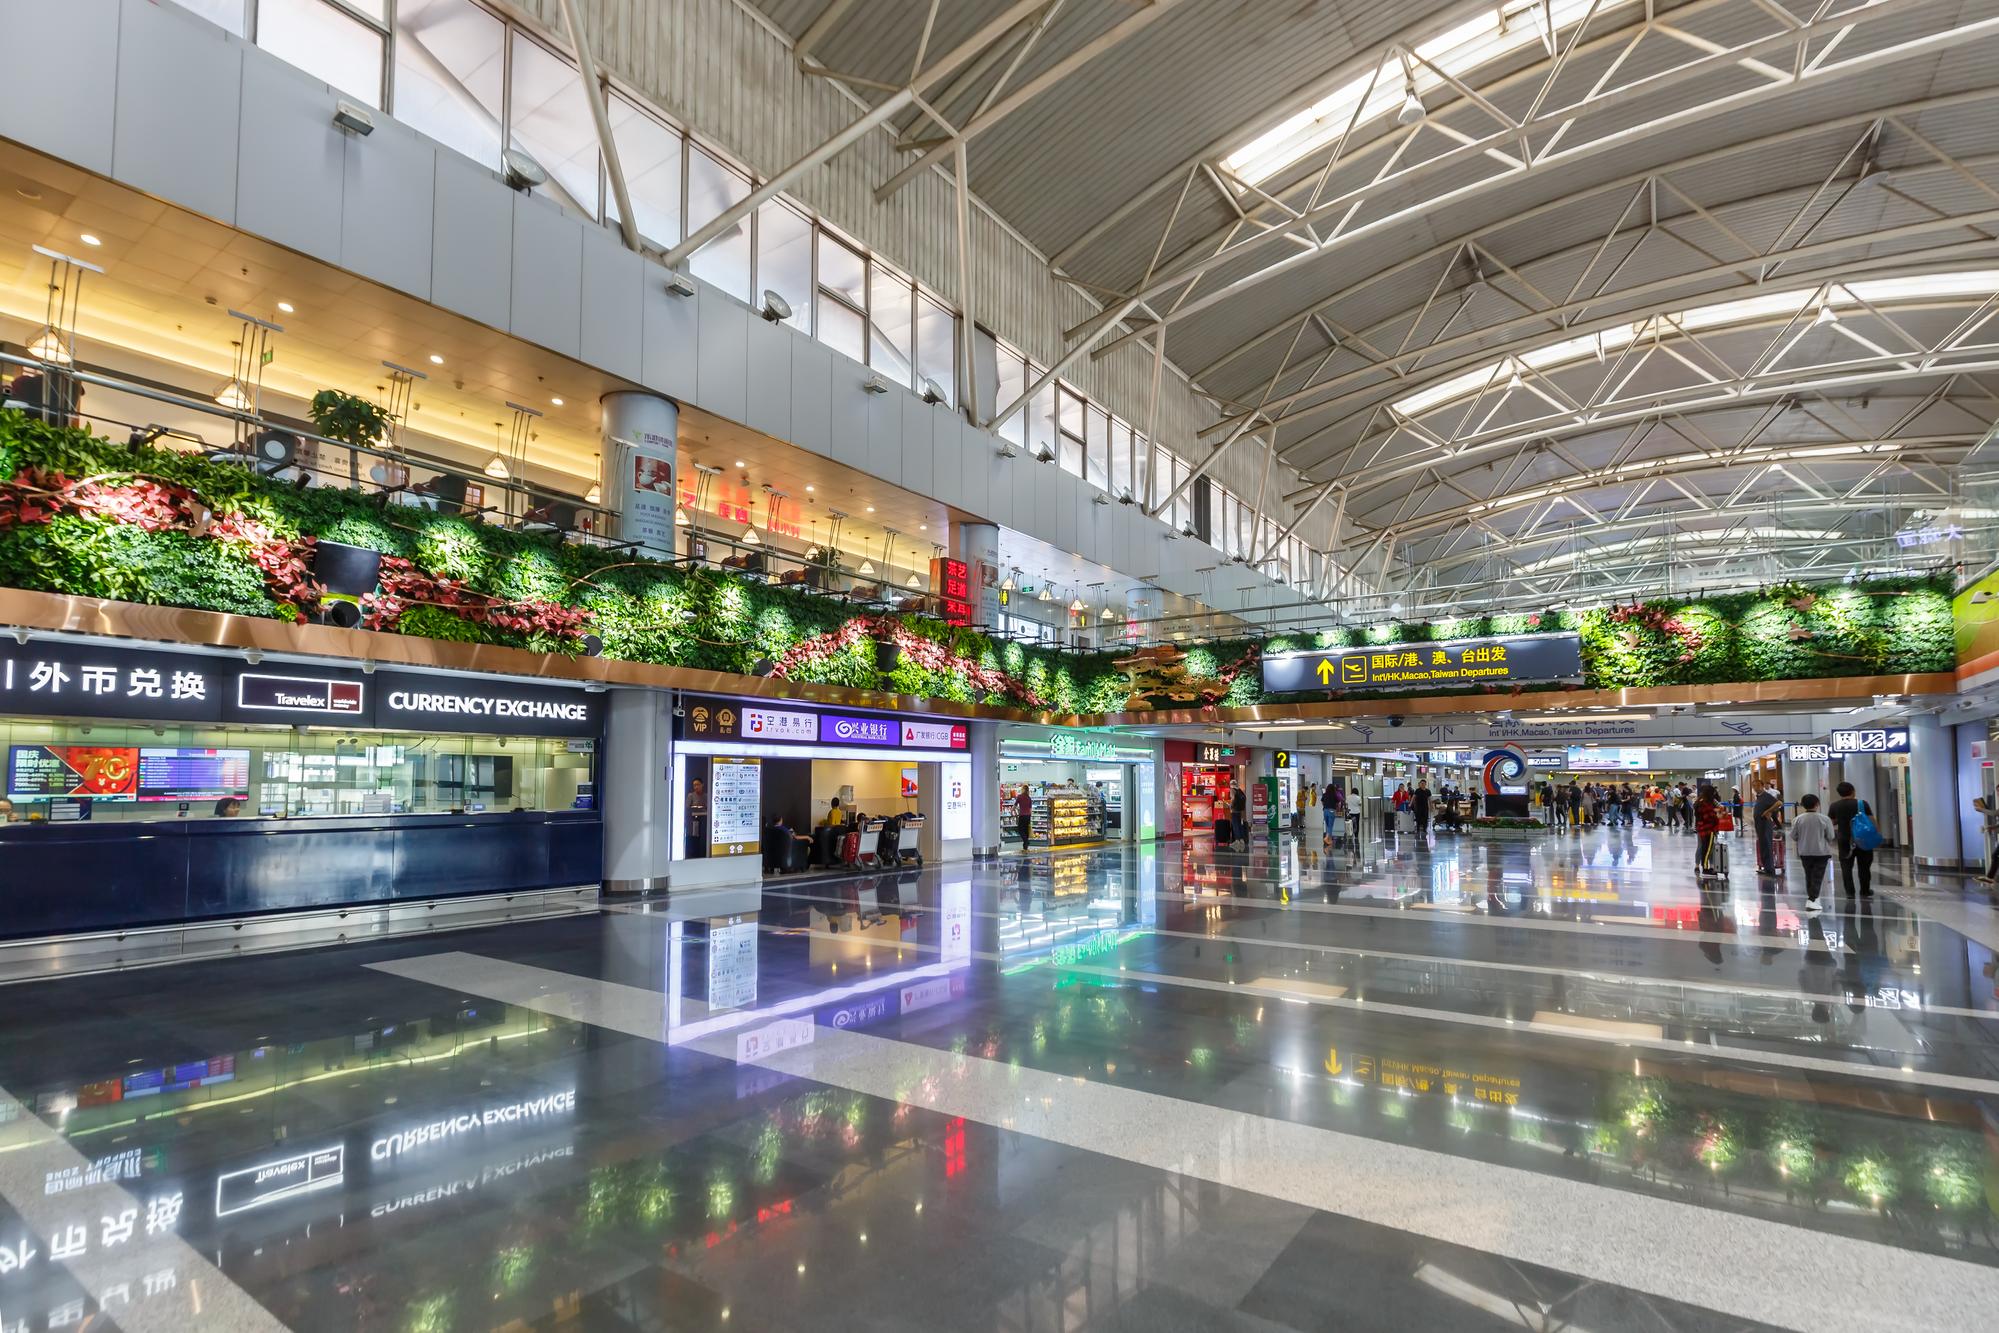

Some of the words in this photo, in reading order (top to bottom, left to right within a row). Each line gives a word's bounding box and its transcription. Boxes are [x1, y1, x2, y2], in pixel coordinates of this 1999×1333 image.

[947, 560, 967, 578] 茶艺
[947, 579, 966, 598] 足道
[1371, 646, 1507, 669] 国际/港、澳、台出发
[1460, 666, 1509, 678] Departures
[29, 661, 206, 700] 外币兑换
[274, 693, 325, 707] Travelex
[388, 692, 495, 715] CURRENCY
[495, 699, 587, 721] EXCHANGE
[693, 722, 707, 732] VIP
[851, 722, 888, 736] 兴业银行
[1585, 726, 1635, 735] Departures
[936, 731, 949, 740] CGB
